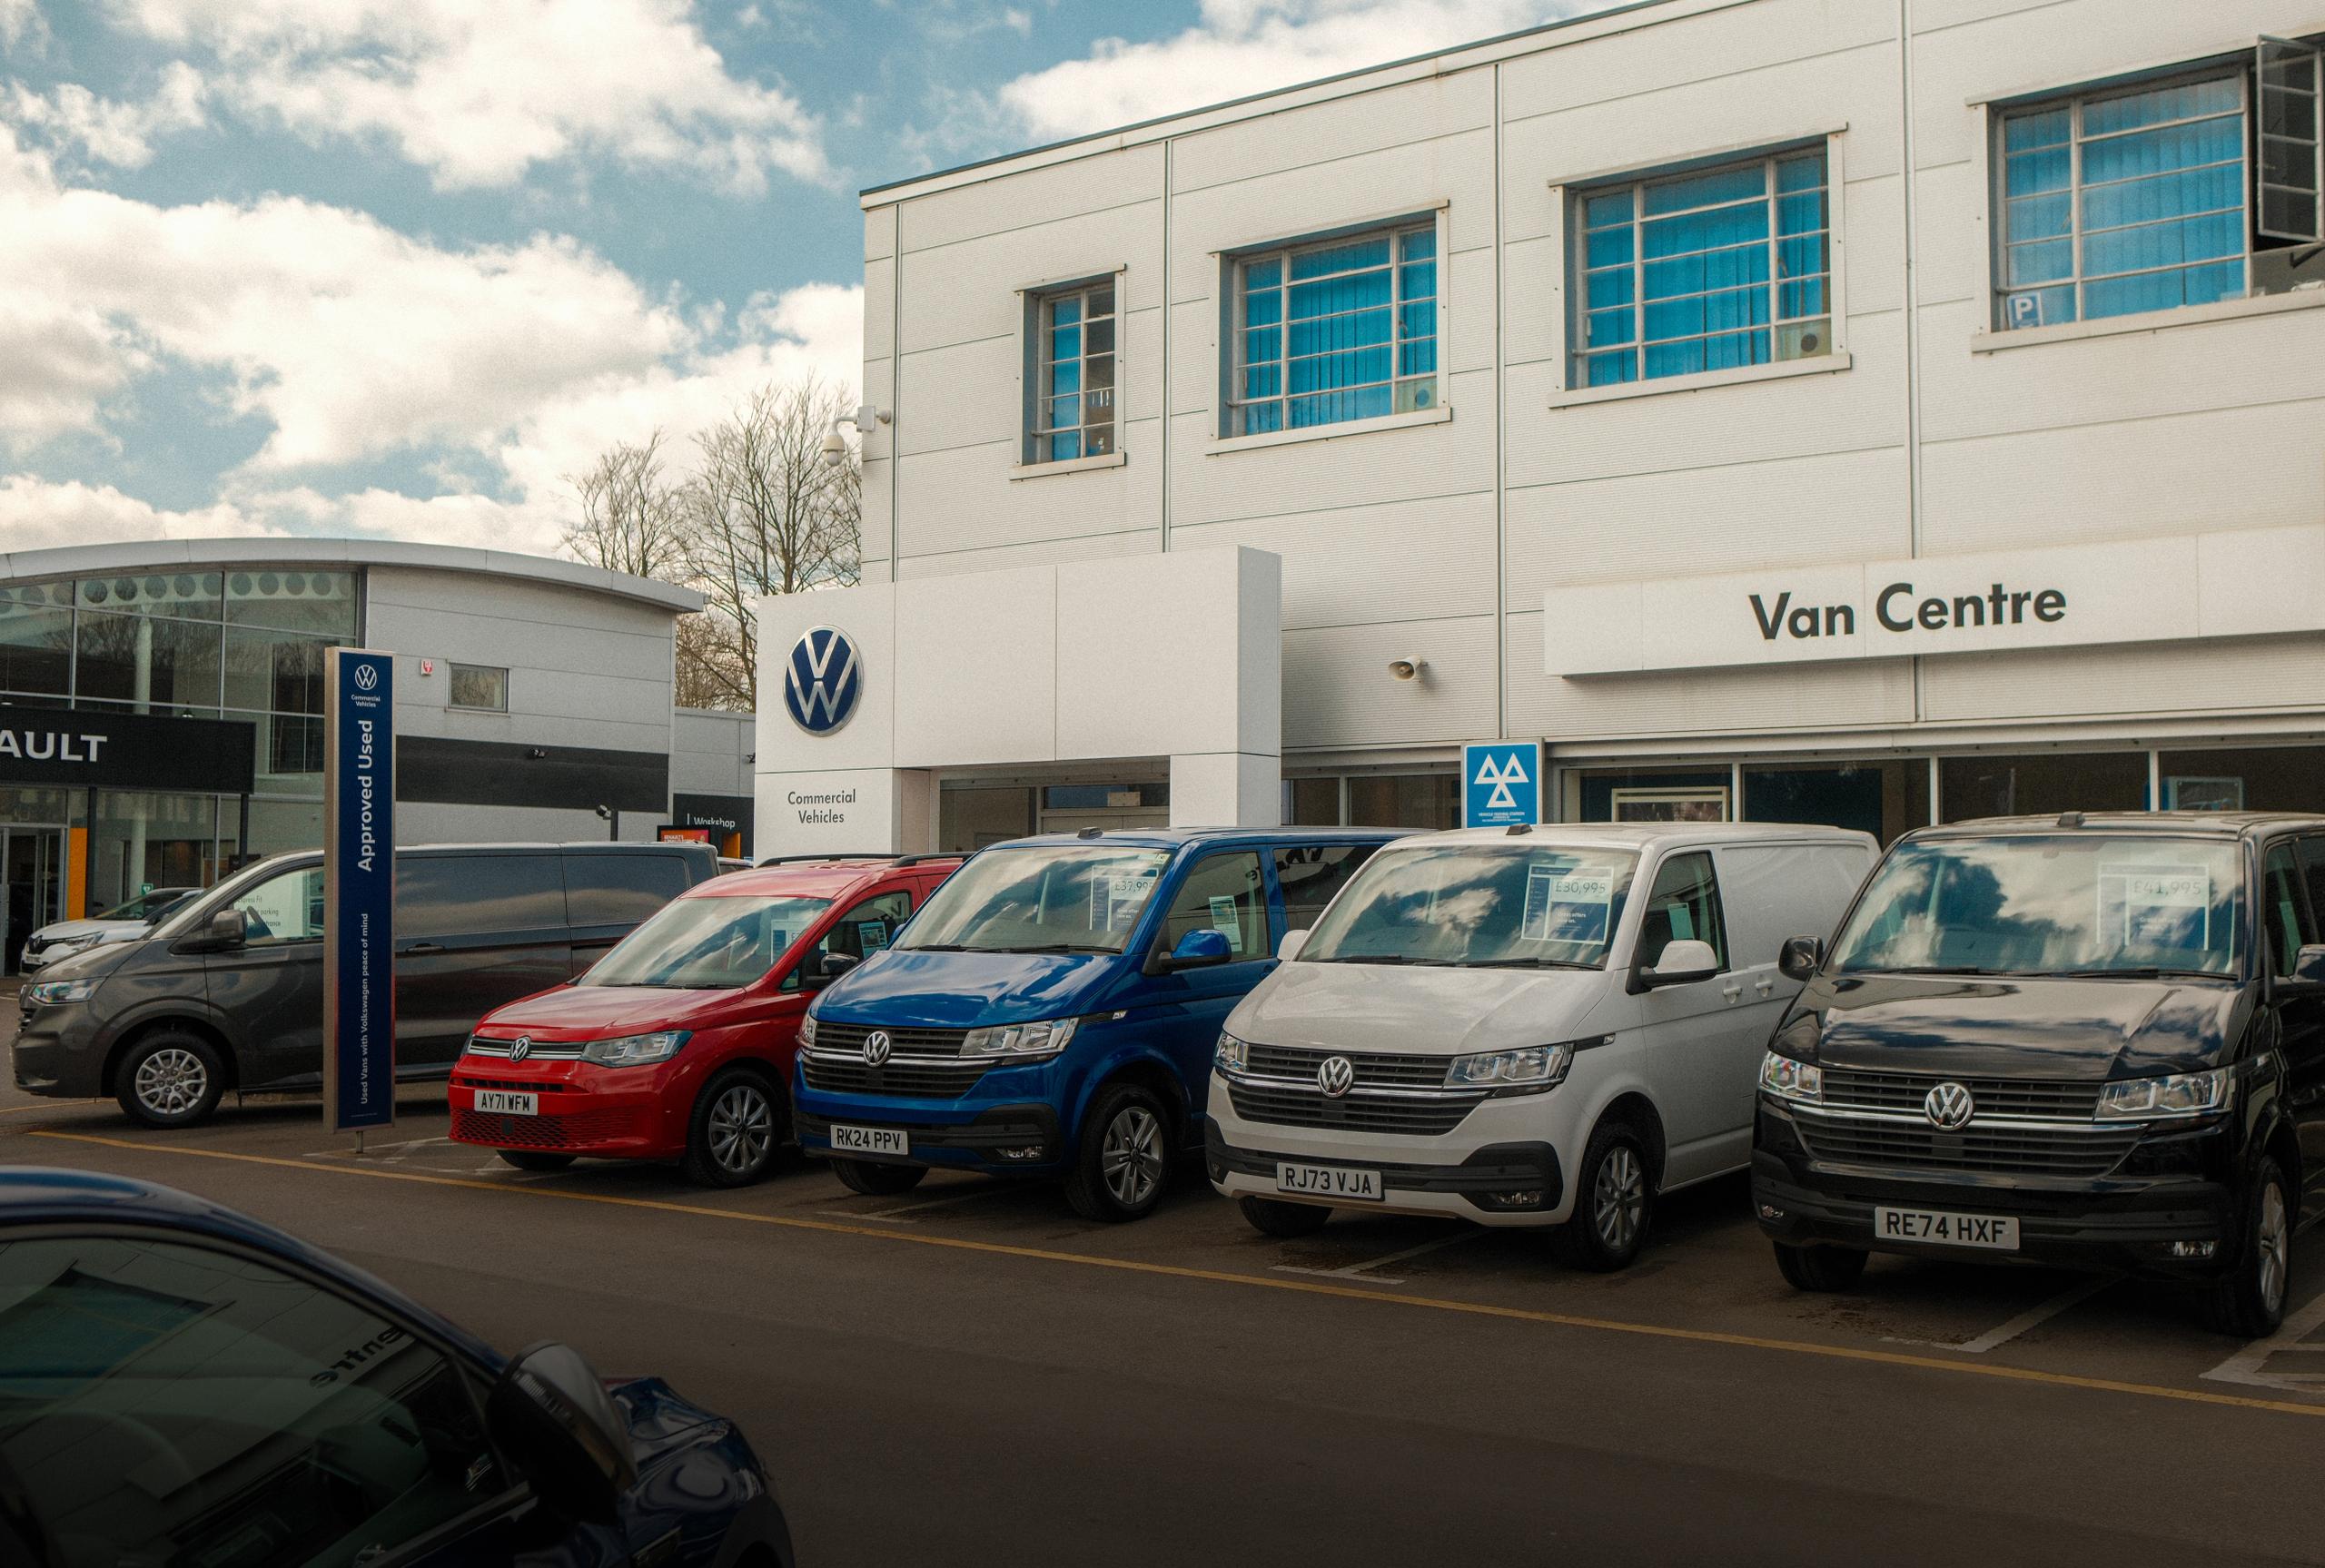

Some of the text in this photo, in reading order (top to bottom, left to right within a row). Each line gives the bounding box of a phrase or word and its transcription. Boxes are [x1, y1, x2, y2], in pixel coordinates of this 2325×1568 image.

[2014, 298, 2033, 321] P
[1748, 583, 2066, 640] Van Centre
[351, 694, 381, 702] Commercial
[0, 729, 108, 763] AULT
[357, 719, 376, 873] Approved Used
[787, 788, 856, 805] Commercial
[693, 816, 736, 831] Workshop
[797, 809, 846, 824] Vehicles
[1555, 882, 1606, 894] £30,995
[2134, 880, 2201, 895] £41,995
[361, 913, 369, 936] mind
[361, 938, 368, 949] of
[361, 950, 370, 977] peace
[361, 978, 370, 1033] Volkswagen
[481, 1092, 530, 1112] AY71 WFM
[836, 1128, 901, 1150] RK24 PPV
[1285, 1167, 1372, 1195] RJ73 VJA
[1886, 1211, 2007, 1243] RE74 HXF
